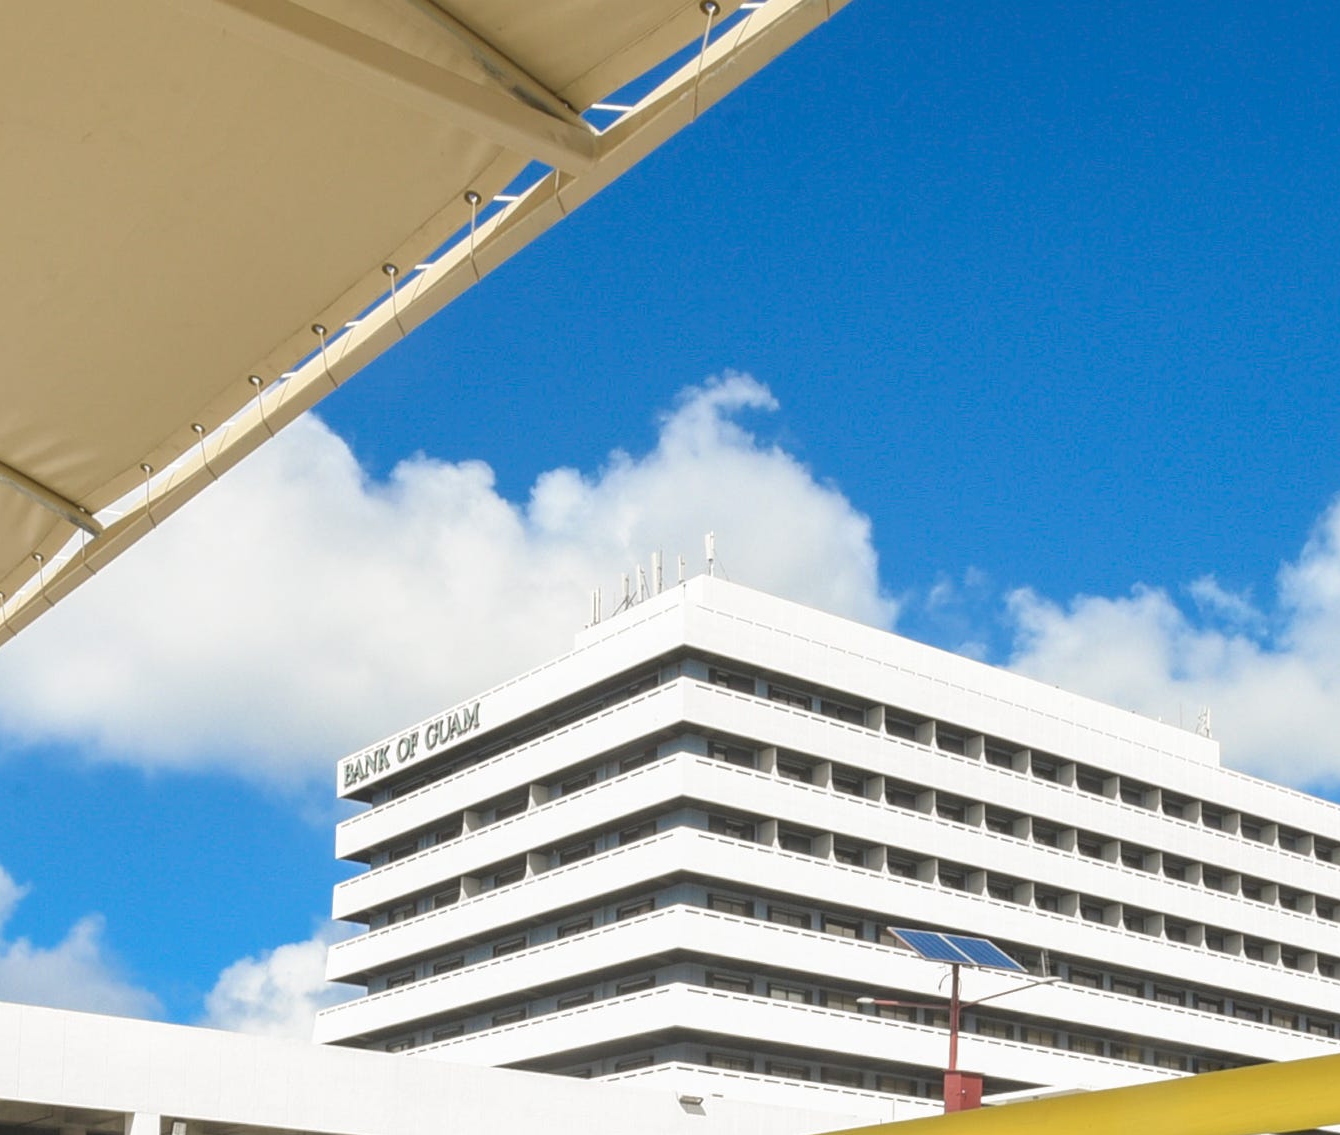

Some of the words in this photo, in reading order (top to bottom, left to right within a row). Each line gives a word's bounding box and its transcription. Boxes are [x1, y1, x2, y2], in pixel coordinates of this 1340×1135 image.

[343, 745, 391, 789] BANK
[396, 731, 419, 765] OF
[424, 702, 481, 751] GUAM
